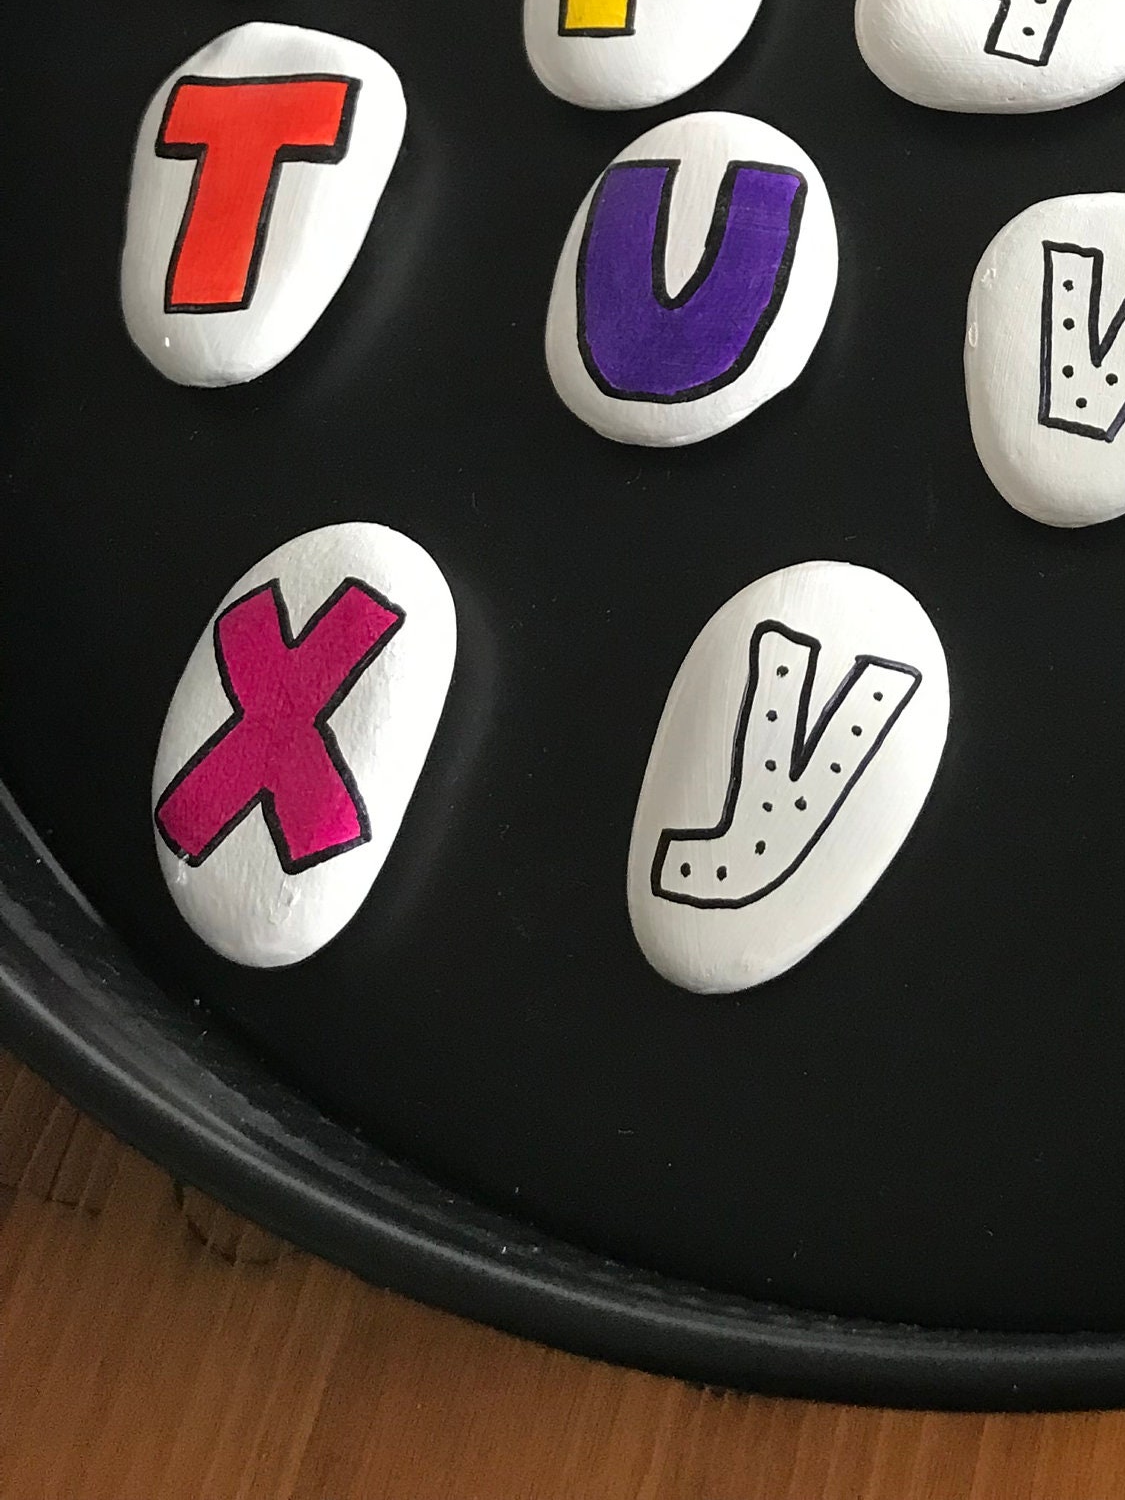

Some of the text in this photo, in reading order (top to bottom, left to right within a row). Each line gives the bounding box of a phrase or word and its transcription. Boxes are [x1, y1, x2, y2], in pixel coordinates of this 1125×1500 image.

[155, 74, 362, 314] T
[575, 158, 807, 404] U
[153, 577, 407, 875] X
[651, 619, 923, 909] y
